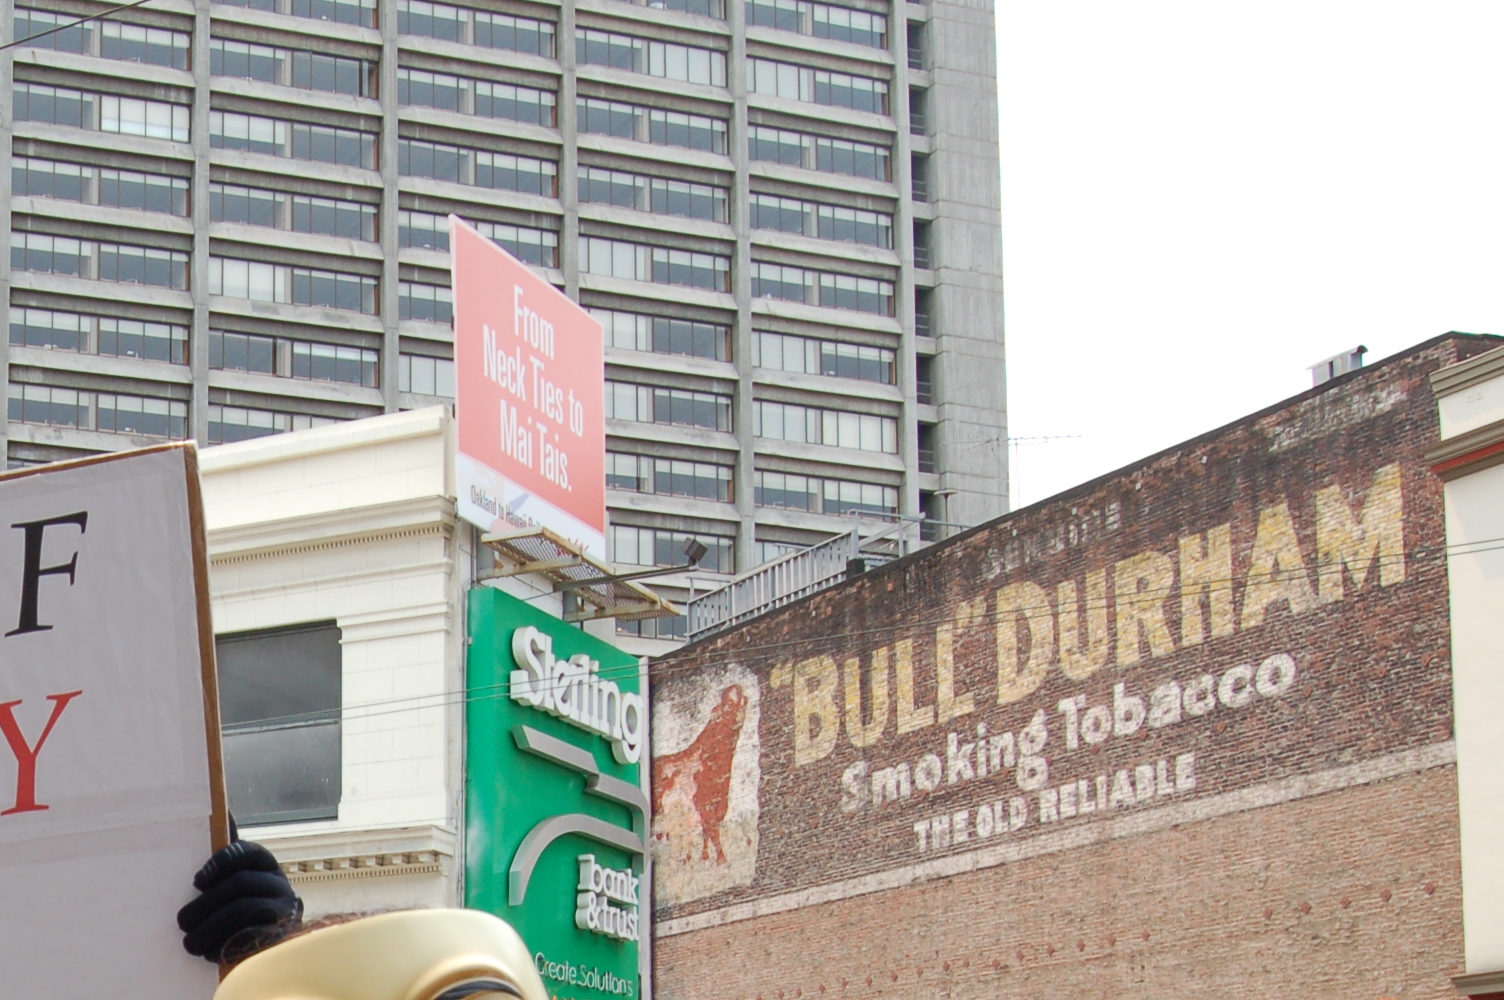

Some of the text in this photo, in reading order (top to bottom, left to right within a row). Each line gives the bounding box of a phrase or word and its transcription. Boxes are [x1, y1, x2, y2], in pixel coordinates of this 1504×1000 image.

[514, 284, 556, 360] From
[483, 324, 584, 438] Neck Ties to
[500, 399, 572, 493] Mai Tais.
[996, 462, 1407, 703] DURHAM
[510, 625, 644, 765] Sterling
[841, 652, 1297, 812] Smoking Tobacco
[913, 753, 1196, 853] THE OLD RELIABLE
[578, 853, 639, 902] bank
[535, 952, 634, 997] Create Solutions
